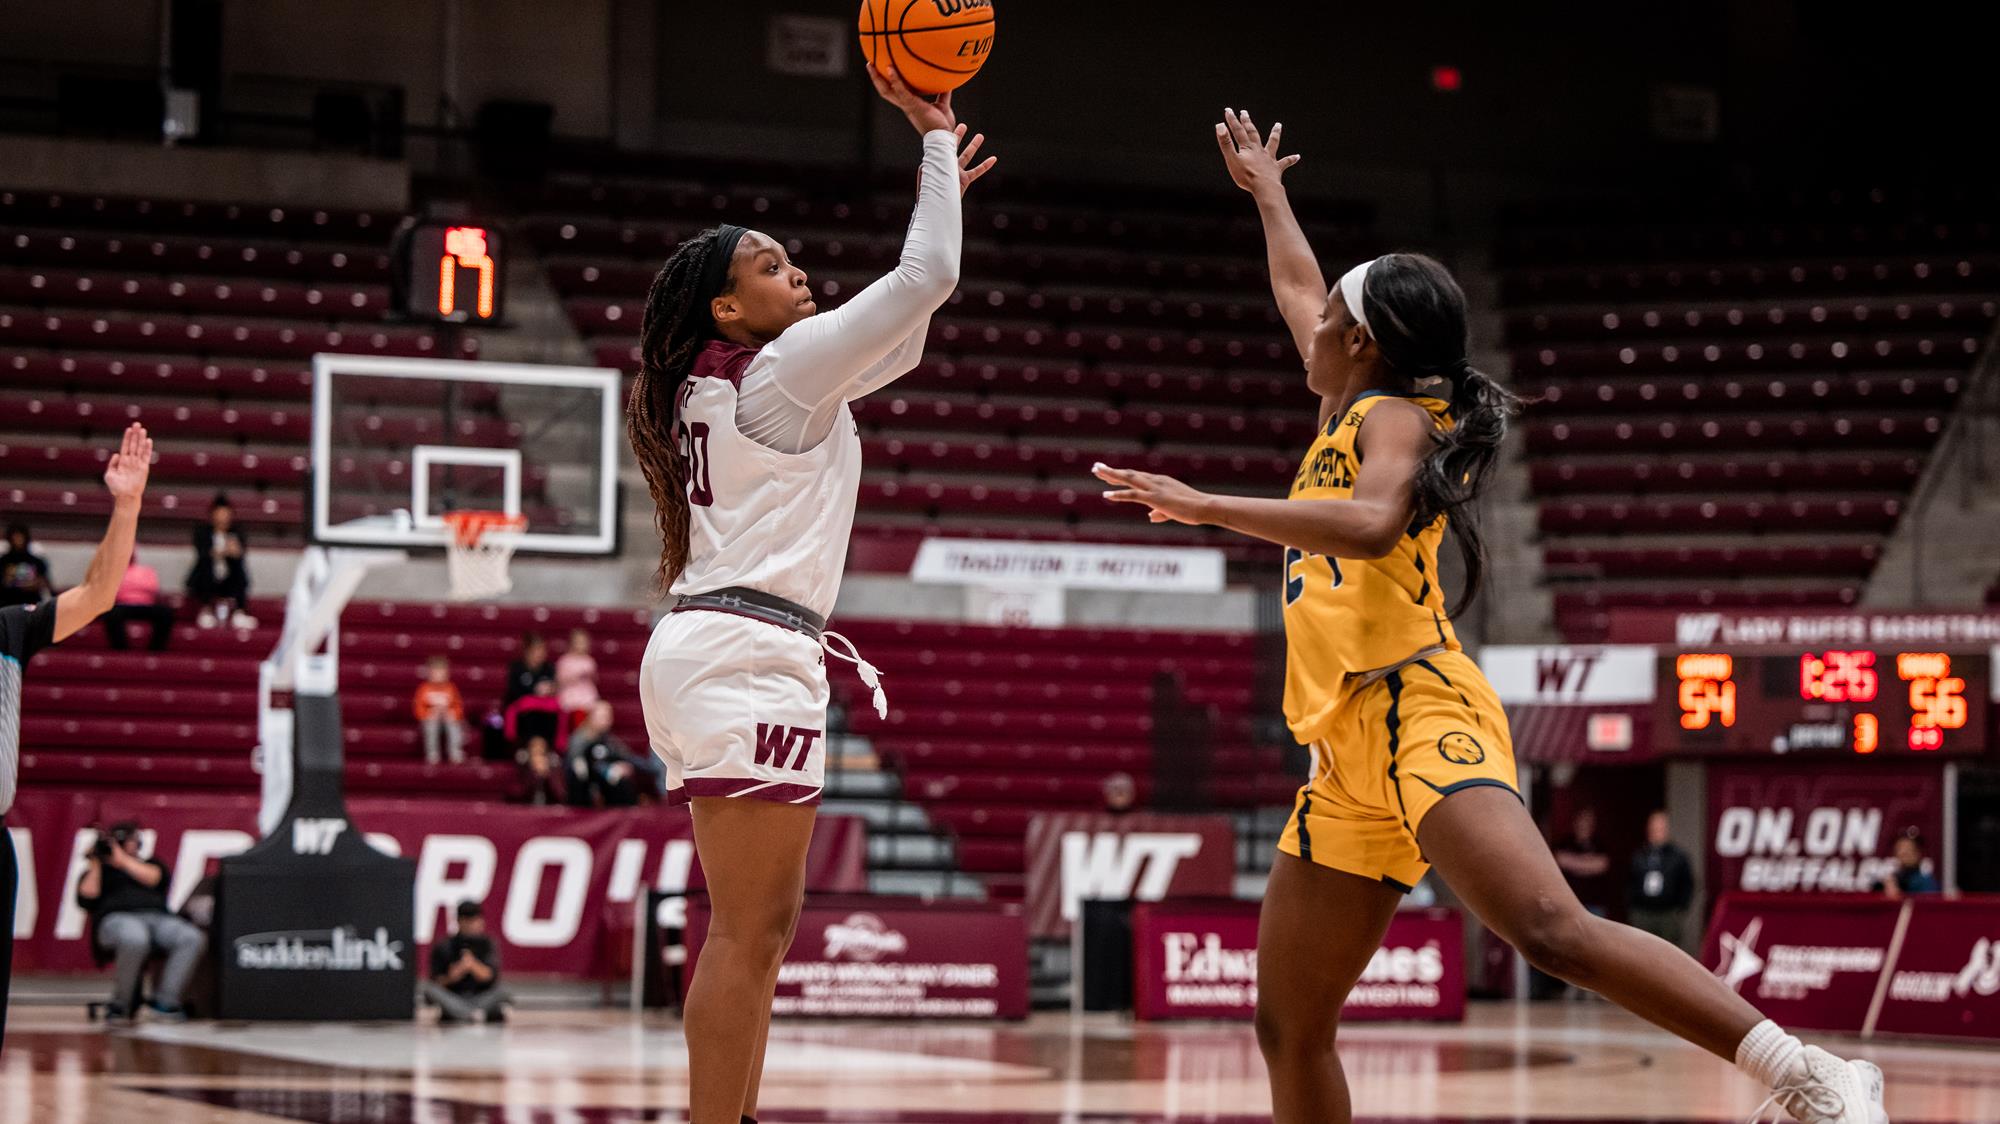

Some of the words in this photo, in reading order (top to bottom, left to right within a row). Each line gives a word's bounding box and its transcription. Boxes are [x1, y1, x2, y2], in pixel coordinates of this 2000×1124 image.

[1723, 615, 1783, 643] LADY
[1787, 615, 1867, 643] BUFFS
[1870, 615, 2000, 643] BASKETBA
[1536, 649, 1605, 697] WT
[1679, 676, 1736, 729] 54
[1909, 677, 1968, 729] 56
[753, 722, 822, 771] WT
[293, 817, 347, 854] WT
[1804, 807, 1882, 857] ON
[1060, 831, 1203, 921] WT
